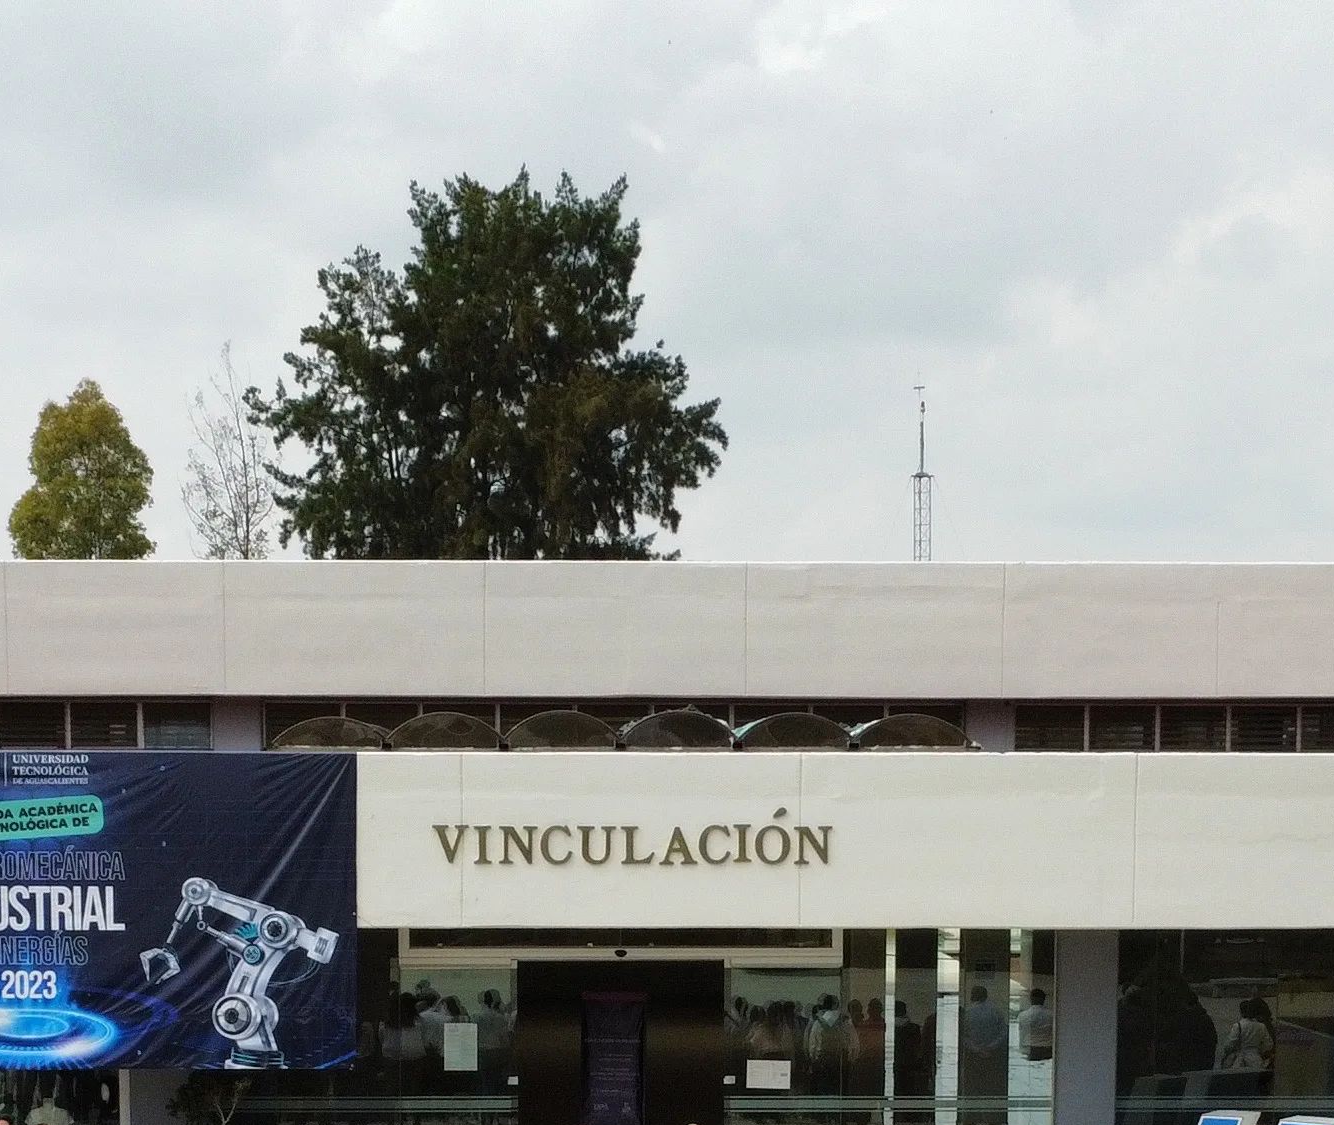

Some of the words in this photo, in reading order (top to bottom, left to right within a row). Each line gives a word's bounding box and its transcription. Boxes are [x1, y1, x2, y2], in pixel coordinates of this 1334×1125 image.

[12, 754, 89, 764] UNIVERSIDAD
[12, 765, 89, 776] TECNOLÓGICA
[12, 777, 22, 785] DE
[24, 777, 89, 785] AGUASCALIENTES
[19, 802, 98, 819] ACADÉMICA
[72, 816, 90, 828] DE
[431, 806, 834, 866] VINCULACIÓN
[0, 969, 58, 1000] 2023
